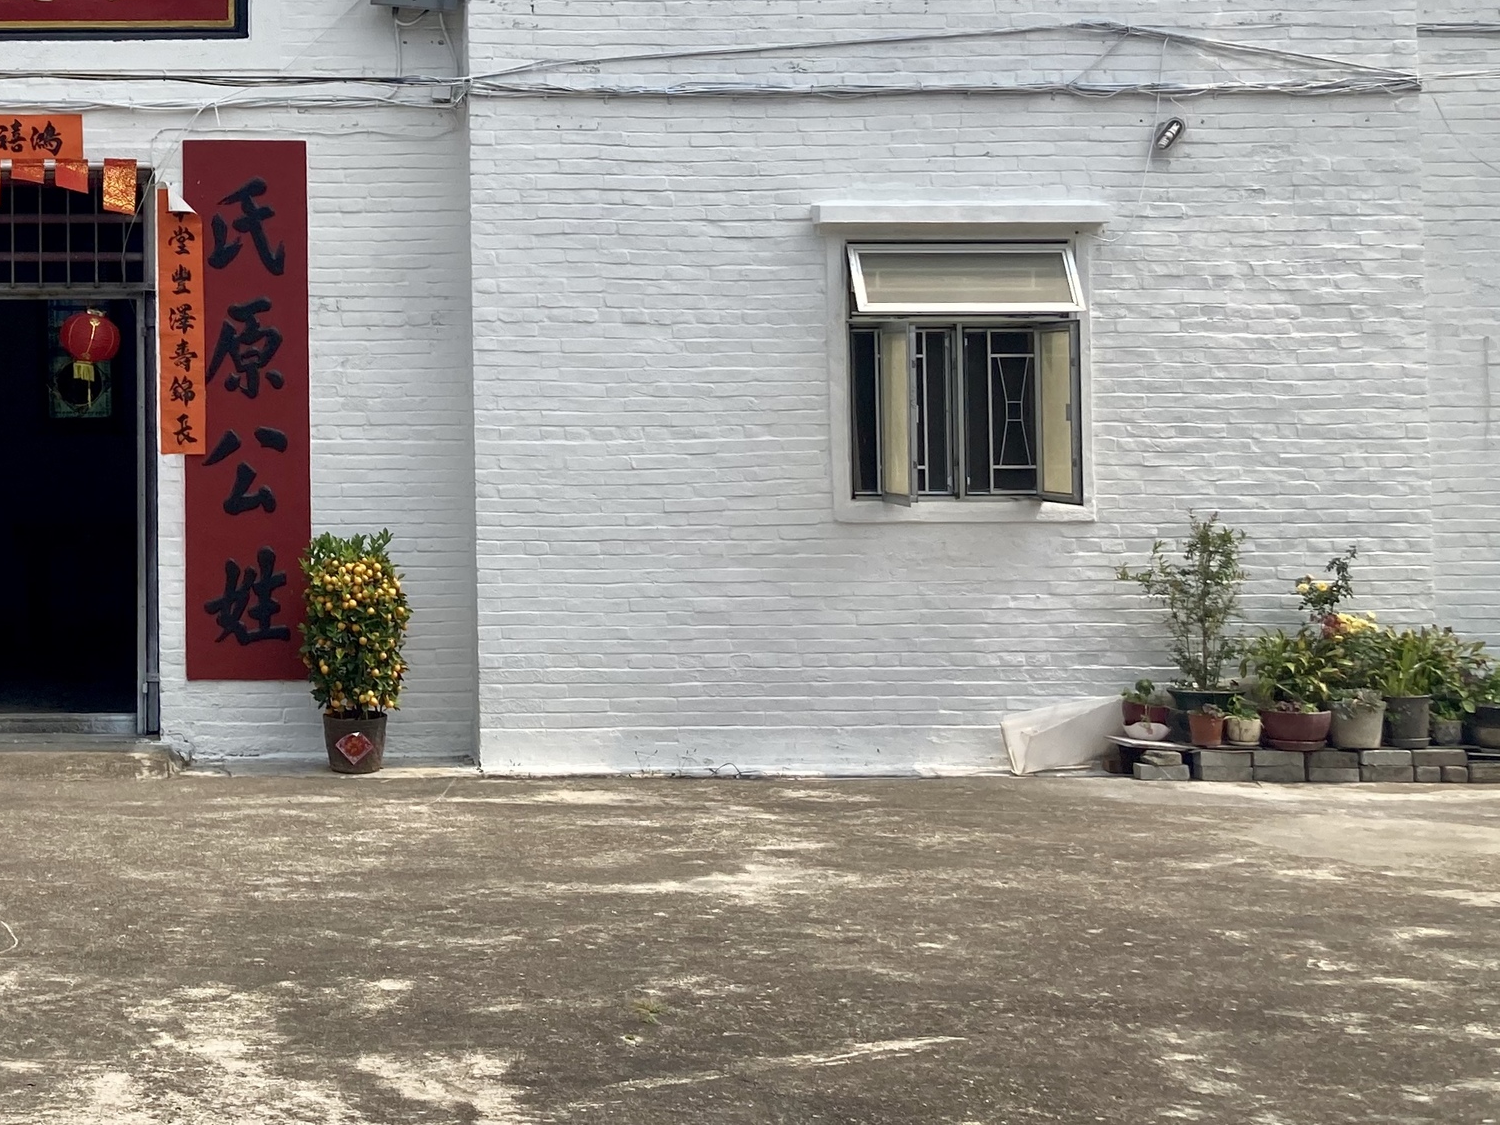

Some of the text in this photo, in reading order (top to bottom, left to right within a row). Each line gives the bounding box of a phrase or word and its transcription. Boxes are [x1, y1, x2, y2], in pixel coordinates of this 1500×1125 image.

[168, 212, 198, 446] 堂豐澤壽錦長
[203, 176, 289, 645] 氏原公姓
